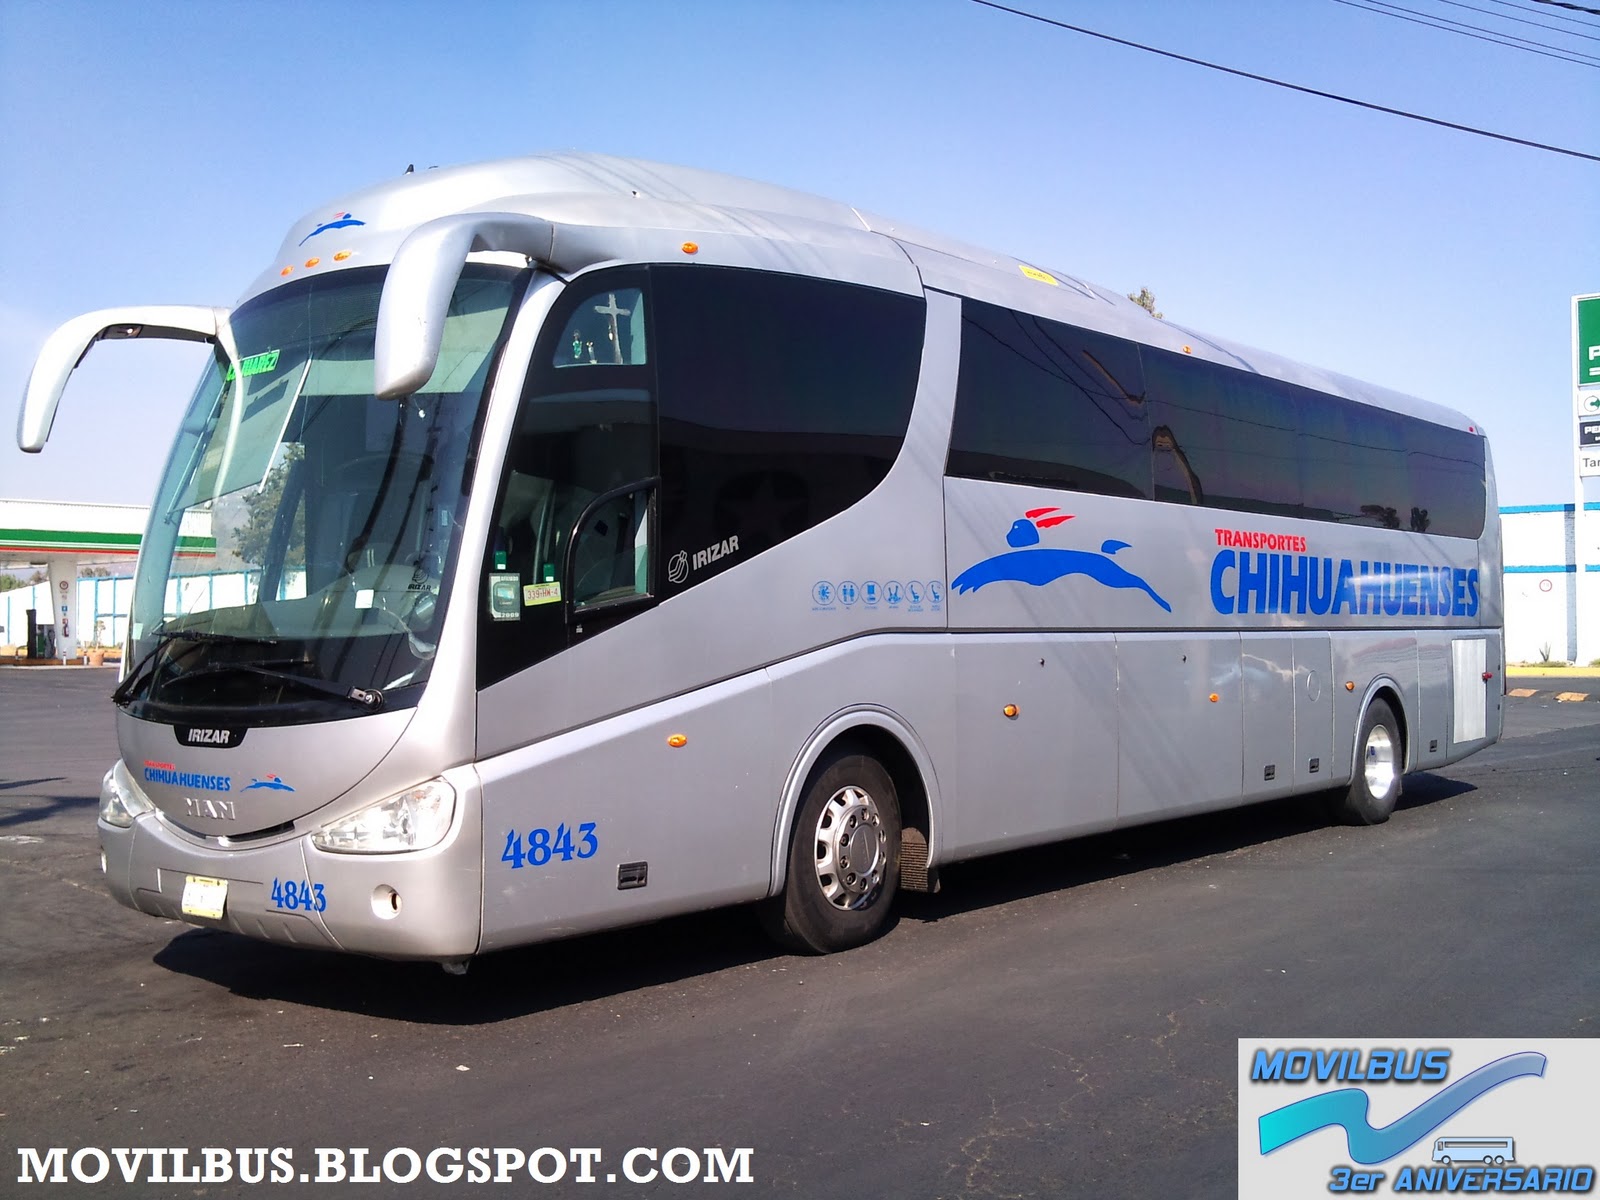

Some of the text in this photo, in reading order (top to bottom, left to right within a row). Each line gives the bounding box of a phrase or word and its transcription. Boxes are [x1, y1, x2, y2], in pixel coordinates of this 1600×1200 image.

[692, 535, 739, 571] IRIZAR
[1214, 528, 1307, 553] TRANSPORTES
[1210, 549, 1479, 618] CHIHUAHUENSES
[188, 728, 230, 744] IRIZAR
[144, 767, 231, 791] CHIHUAHUENSES
[501, 822, 598, 869] 4843
[271, 877, 326, 912] 4843
